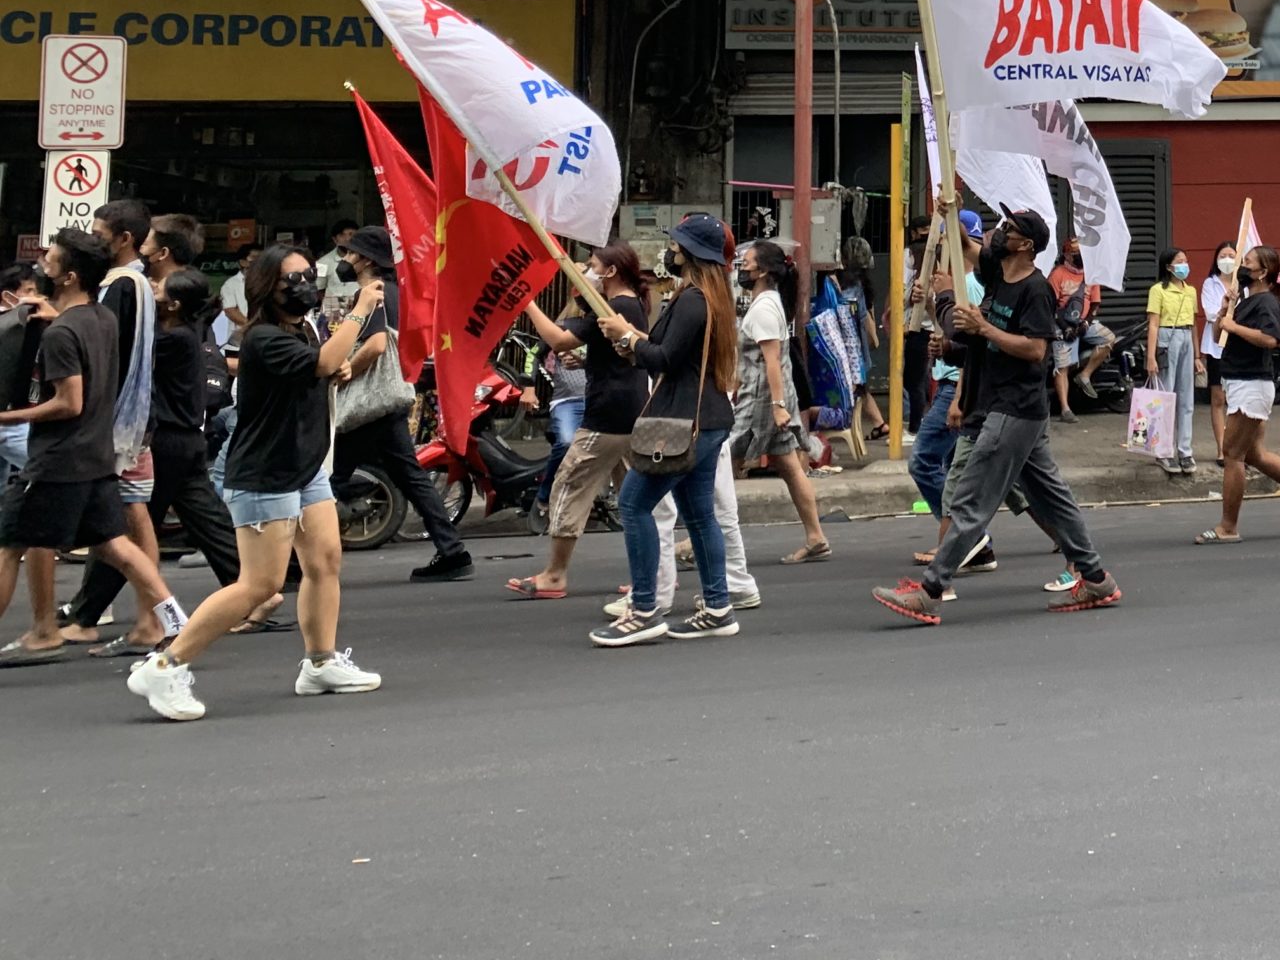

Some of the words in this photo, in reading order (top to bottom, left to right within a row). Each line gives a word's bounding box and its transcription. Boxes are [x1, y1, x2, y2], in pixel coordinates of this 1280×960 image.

[733, 8, 921, 27] INSITUTE
[113, 12, 385, 47] CORPORAT
[993, 63, 1079, 81] CENTRAL
[1083, 65, 1152, 82] VISAYAS
[71, 88, 94, 100] NO
[49, 103, 115, 116] STOPPING
[58, 119, 106, 128] ANYTIME
[59, 202, 90, 217] NO
